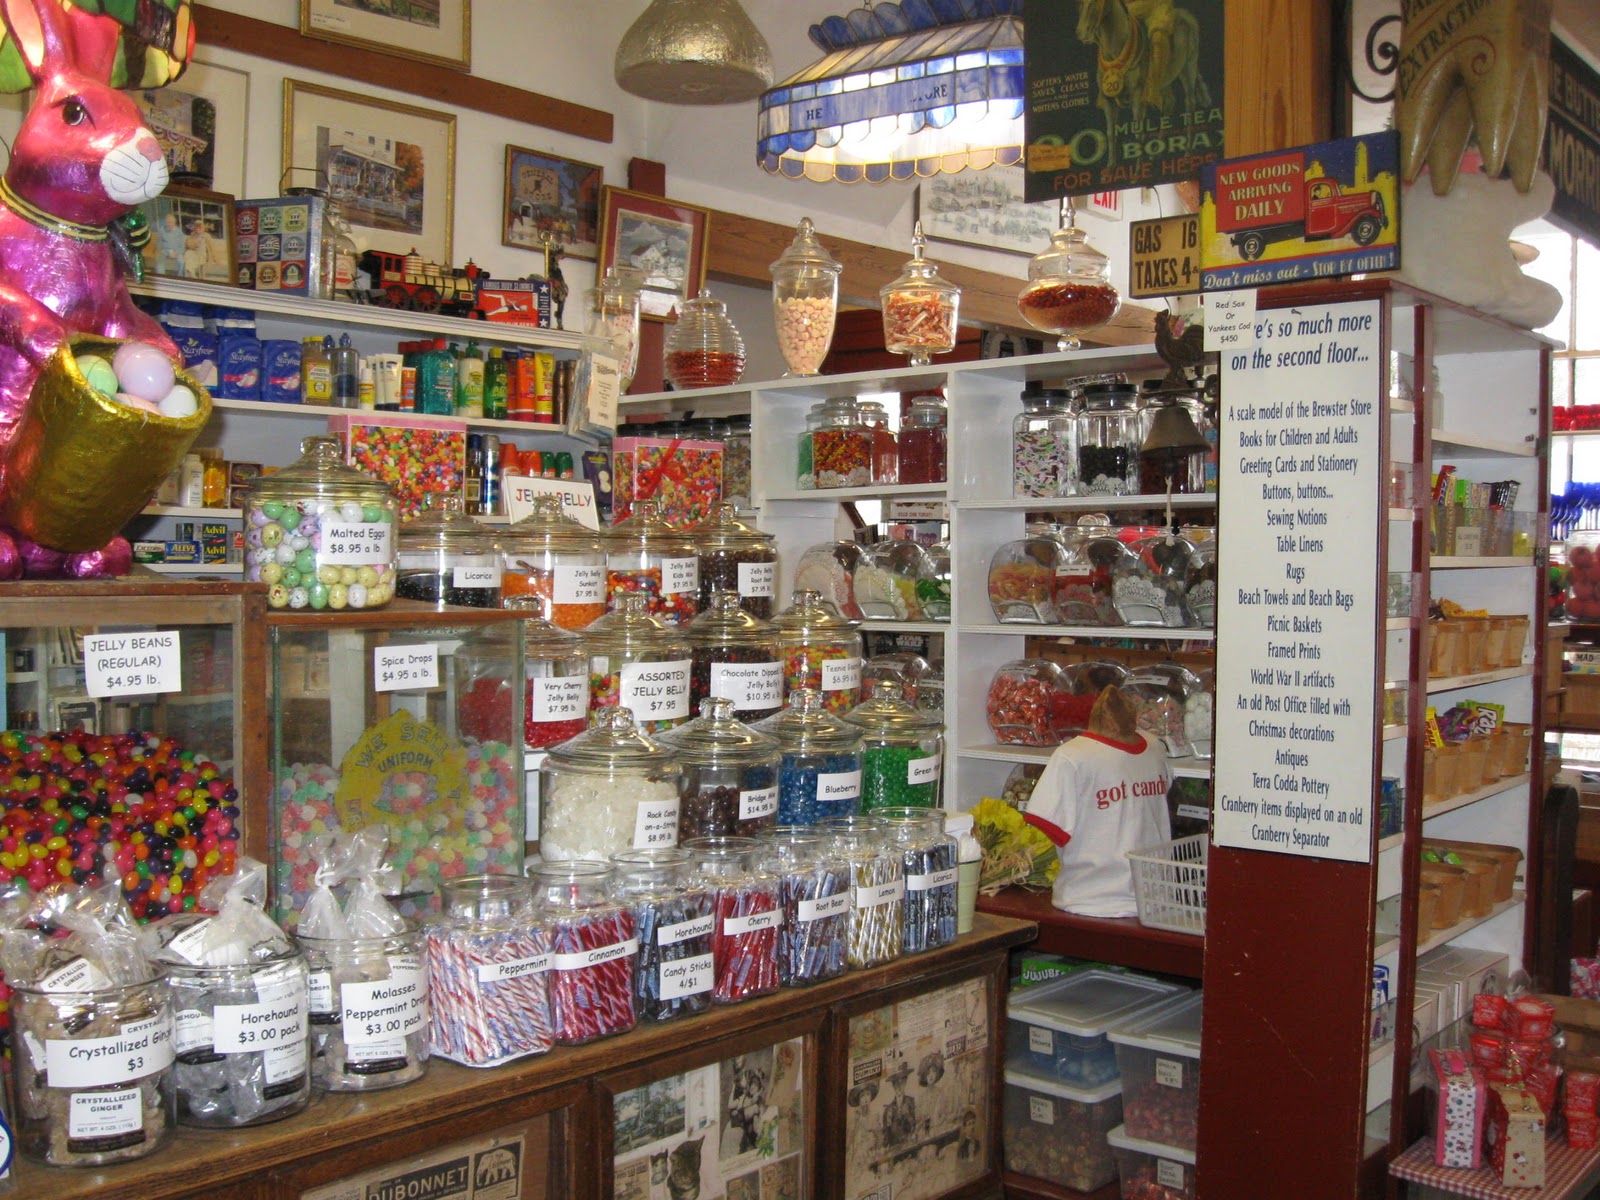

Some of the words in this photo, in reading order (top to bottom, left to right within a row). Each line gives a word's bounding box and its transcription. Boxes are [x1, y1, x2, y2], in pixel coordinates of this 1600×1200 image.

[1114, 115, 1173, 136] MULE
[1053, 172, 1093, 192] FOR
[1100, 161, 1152, 184] SALE
[1220, 170, 1248, 186] NEW
[1252, 161, 1300, 180] GOODS
[1229, 181, 1291, 202] ARRIVING
[1235, 198, 1285, 221] DAILY
[1134, 224, 1162, 254] GAS
[1181, 220, 1198, 249] 16
[1134, 256, 1177, 290] TAXES
[1181, 256, 1191, 284] 4
[1203, 271, 1240, 289] Don't
[1242, 269, 1272, 284] miss
[1276, 264, 1300, 280] out
[1339, 258, 1353, 272] BY
[1215, 301, 1230, 309] Red
[1231, 300, 1246, 308] Sox
[1225, 312, 1236, 320] Or
[1278, 322, 1292, 338] so
[1297, 312, 1332, 335] much
[1338, 314, 1372, 332] more
[1207, 323, 1236, 333] Yankees
[1220, 334, 1239, 344] $450
[1232, 354, 1247, 370] on
[1252, 346, 1272, 369] the
[1276, 342, 1321, 367] second
[1327, 341, 1369, 364] floor...
[1228, 406, 1234, 421] A
[1236, 404, 1256, 421] scale
[1258, 402, 1283, 420] model
[1285, 401, 1294, 418] of
[1296, 401, 1310, 418] the
[1312, 400, 1348, 418] Brewster
[1350, 398, 1372, 416] Store
[1240, 430, 1262, 447] Books
[1266, 430, 1276, 447] for
[1279, 427, 1312, 446] Children
[1315, 427, 1330, 445] and
[1332, 426, 1358, 444] Adults
[1240, 456, 1272, 478] Greeting
[1275, 456, 1297, 473] Cards
[1300, 455, 1314, 473] and
[1317, 454, 1358, 476] Stationery
[1262, 484, 1294, 503] Buttons,
[1296, 482, 1334, 500] buttons...
[1266, 509, 1294, 530] Sewing
[1297, 509, 1328, 526] Notions
[203, 525, 226, 535] Advil
[330, 527, 363, 540] Malted
[367, 528, 385, 543] Eggs
[172, 544, 196, 553] ALEVE
[205, 546, 226, 555] Advil
[330, 542, 360, 555] $8.95
[370, 542, 383, 553] lb.
[1276, 536, 1296, 553] Table
[1299, 535, 1324, 553] Linens
[464, 571, 493, 580] Licorice
[1286, 563, 1305, 583] Rugs
[1238, 588, 1261, 606] Beach
[1264, 588, 1289, 606] Towels
[1292, 590, 1306, 606] and
[1309, 589, 1333, 606] Beach
[1335, 590, 1354, 612] Bags
[1267, 616, 1290, 632] Picnic
[1293, 616, 1322, 633] Baskets
[90, 640, 127, 653] JELLY
[131, 637, 173, 650] BEANS
[1268, 642, 1296, 659] Framed
[1298, 643, 1320, 660] Prints
[97, 654, 162, 672] (REGULAR)
[381, 656, 404, 668] Spice
[407, 653, 433, 666] Drops
[1575, 652, 1595, 663] MAD
[106, 674, 142, 689] $4.95
[146, 674, 161, 686] lb.
[382, 670, 411, 682] $4.95
[420, 668, 433, 678] lb.
[637, 671, 685, 682] ASSORTED
[720, 669, 759, 677] Chocolate
[761, 668, 780, 679] Dipped
[1250, 668, 1274, 686] World
[1276, 670, 1292, 686] War
[1294, 670, 1300, 687] II
[1303, 670, 1335, 688] artifacts
[544, 683, 562, 691] Very
[563, 682, 582, 690] Cherry
[632, 687, 663, 697] JELLY
[665, 685, 687, 696] BELLY
[650, 700, 676, 711] $7.95
[745, 692, 771, 702] $10.95
[1237, 694, 1248, 710] An
[1250, 694, 1262, 711] old
[1264, 696, 1280, 713] Post
[1284, 696, 1307, 714] Office
[1310, 698, 1330, 715] filled
[1332, 700, 1351, 716] with
[1248, 720, 1286, 739] Christmas
[1289, 724, 1335, 742] decorations
[356, 733, 388, 769] WE
[400, 722, 449, 760] SELL
[378, 751, 433, 773] UNIFORM
[1274, 749, 1308, 770] Antiques
[825, 785, 857, 794] Blueberry
[1096, 780, 1128, 810] got
[1252, 772, 1271, 790] Terra
[1274, 774, 1298, 792] Codda
[1301, 776, 1330, 800] Pottery
[1222, 794, 1258, 819] Cranberry
[1261, 798, 1282, 817] items
[1284, 800, 1322, 824] displayed
[1324, 808, 1334, 823] on
[1337, 809, 1347, 824] an
[1350, 807, 1363, 825] old
[1252, 824, 1290, 848] Cranberry
[1293, 827, 1330, 850] Separator
[878, 887, 896, 898] Lemon
[815, 902, 829, 912] Root
[831, 899, 845, 909] Beer
[674, 921, 713, 939] Horehound
[747, 915, 771, 928] Cherry
[588, 946, 626, 962] Cinnamon
[500, 957, 548, 976] Peppermint
[663, 965, 687, 979] Candy
[689, 960, 712, 972] Sticks
[371, 982, 416, 1001] Molasses
[679, 977, 698, 989] 4/$1
[240, 1003, 299, 1025] Horehound
[345, 1001, 408, 1022] Peppermint
[365, 1019, 401, 1036] $3.00
[404, 1011, 422, 1030] pack
[238, 1027, 277, 1045] $3.00
[280, 1022, 300, 1040] pack
[69, 1036, 148, 1061] Crystallized
[127, 1056, 144, 1072] $3
[75, 1092, 137, 1105] CRYSTALLIZED
[90, 1103, 124, 1113] GINGER
